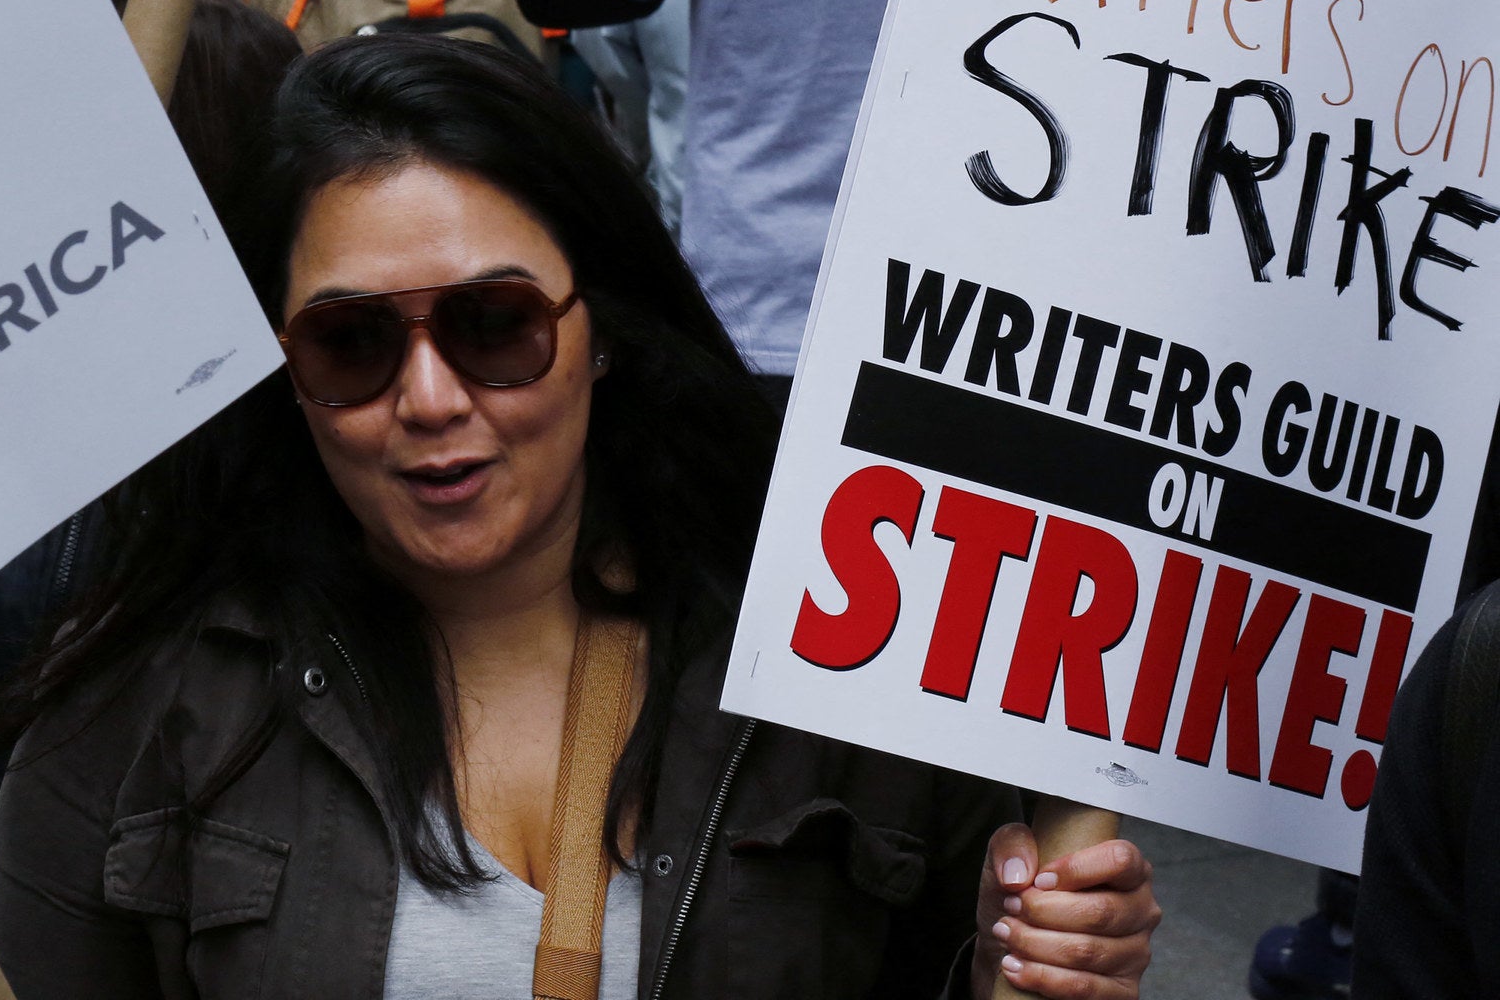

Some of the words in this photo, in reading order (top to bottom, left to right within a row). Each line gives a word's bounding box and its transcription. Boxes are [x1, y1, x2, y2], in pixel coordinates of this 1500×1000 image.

[962, 12, 1500, 341] STRIKE
[883, 258, 1252, 458] WRITERS
[1261, 380, 1444, 521] GUILD
[1148, 462, 1224, 540] ON
[790, 465, 1414, 811] STRIKE!
